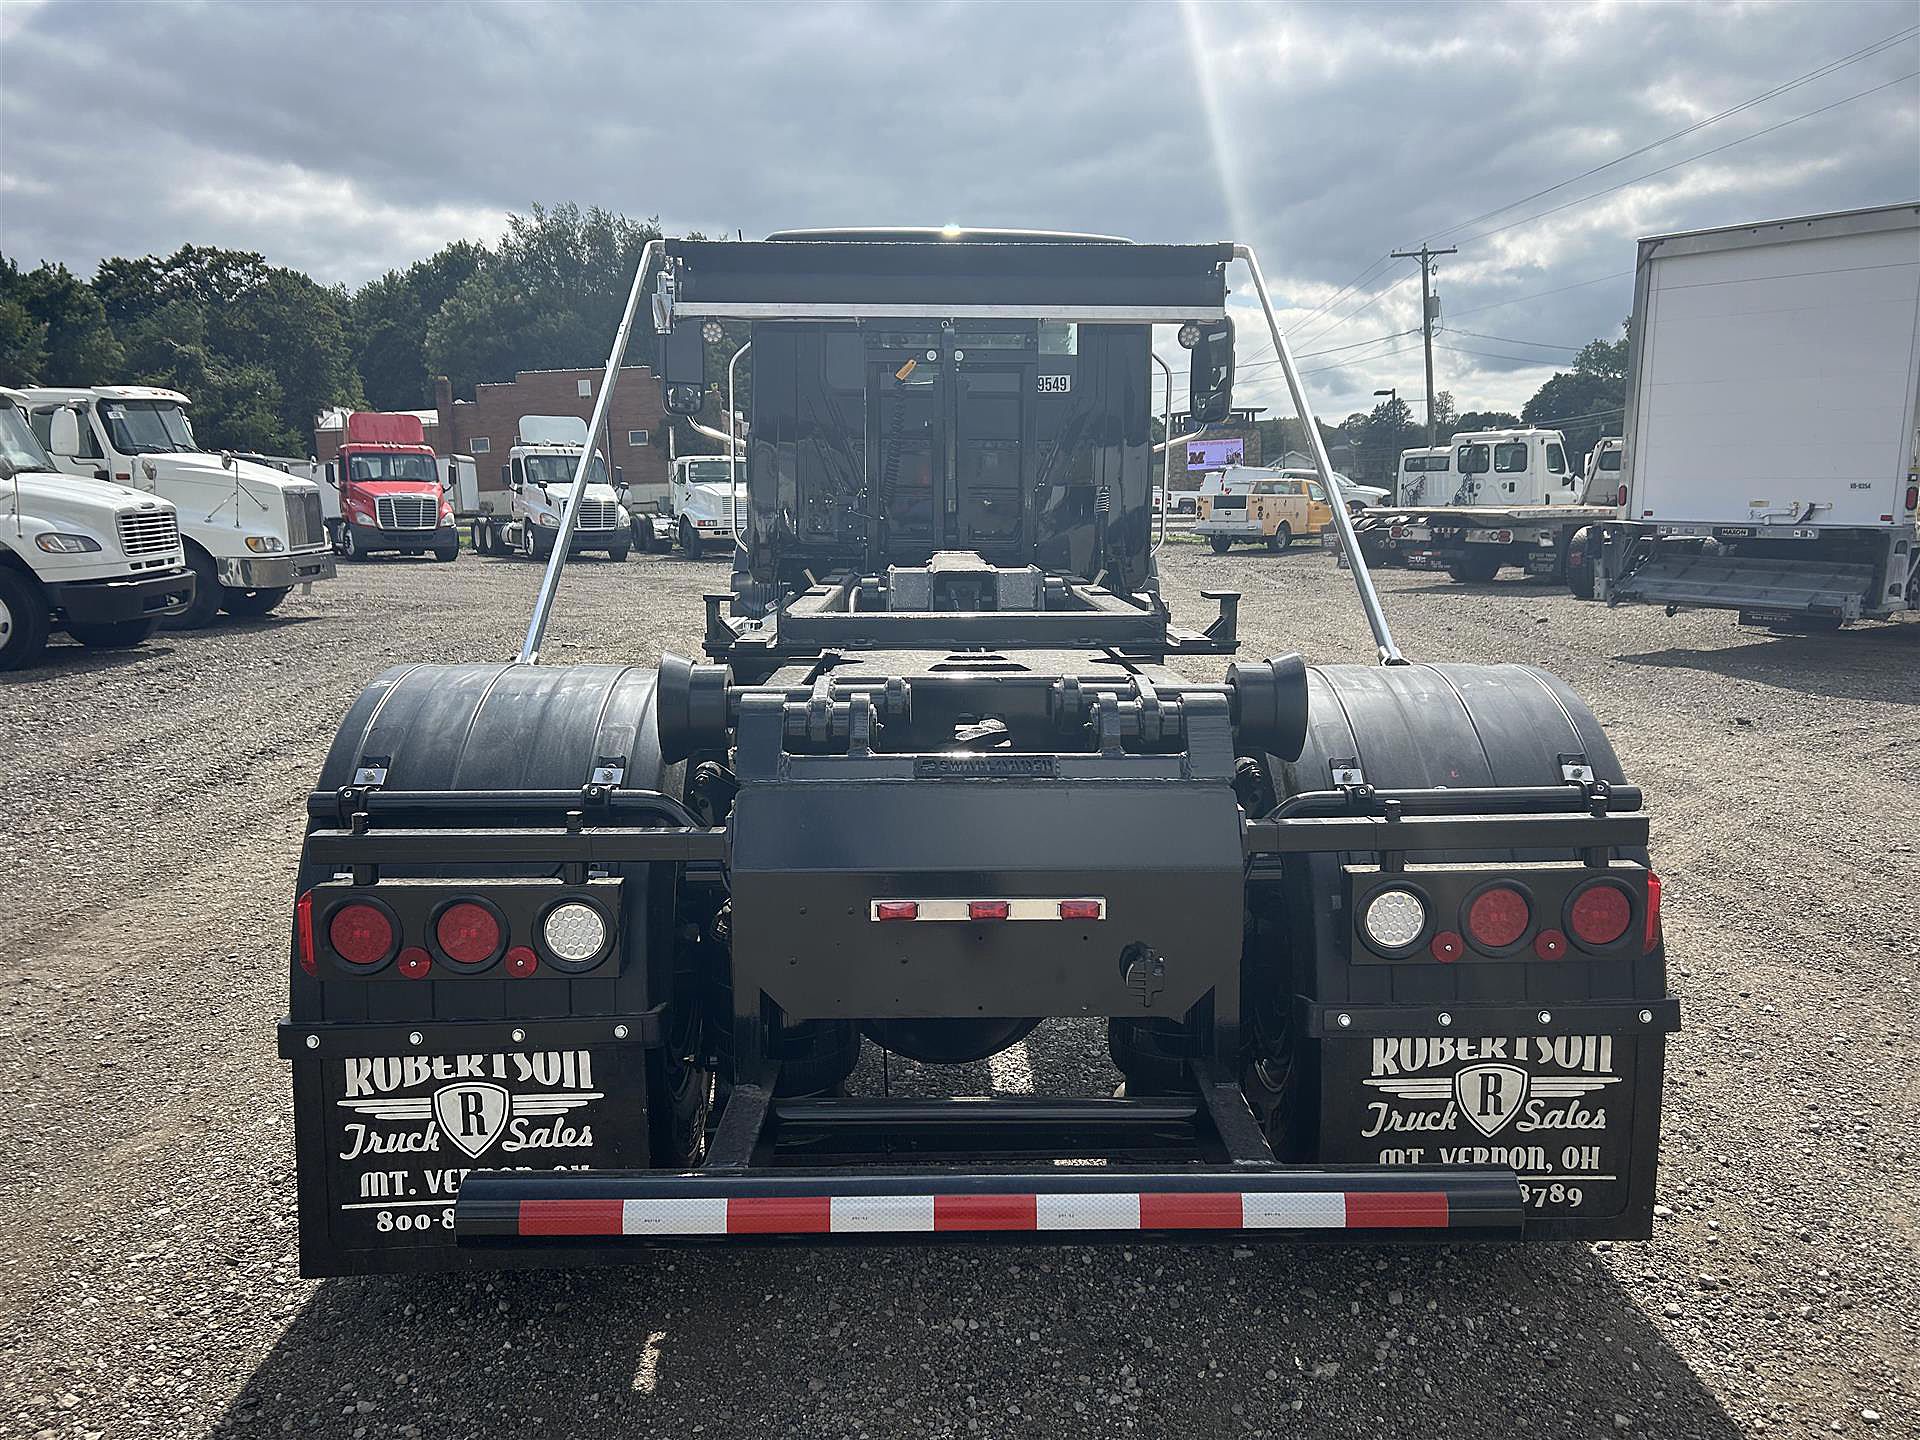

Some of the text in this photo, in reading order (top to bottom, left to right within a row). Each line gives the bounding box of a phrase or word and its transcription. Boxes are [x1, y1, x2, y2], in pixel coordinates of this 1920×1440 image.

[1037, 376, 1067, 392] 9549
[457, 1091, 488, 1138] R
[1477, 1072, 1505, 1118] R
[339, 1116, 594, 1160] Truck Sales
[1361, 1098, 1607, 1138] Truck Sales
[1561, 1146, 1601, 1171] OH
[360, 1170, 418, 1198] MT.
